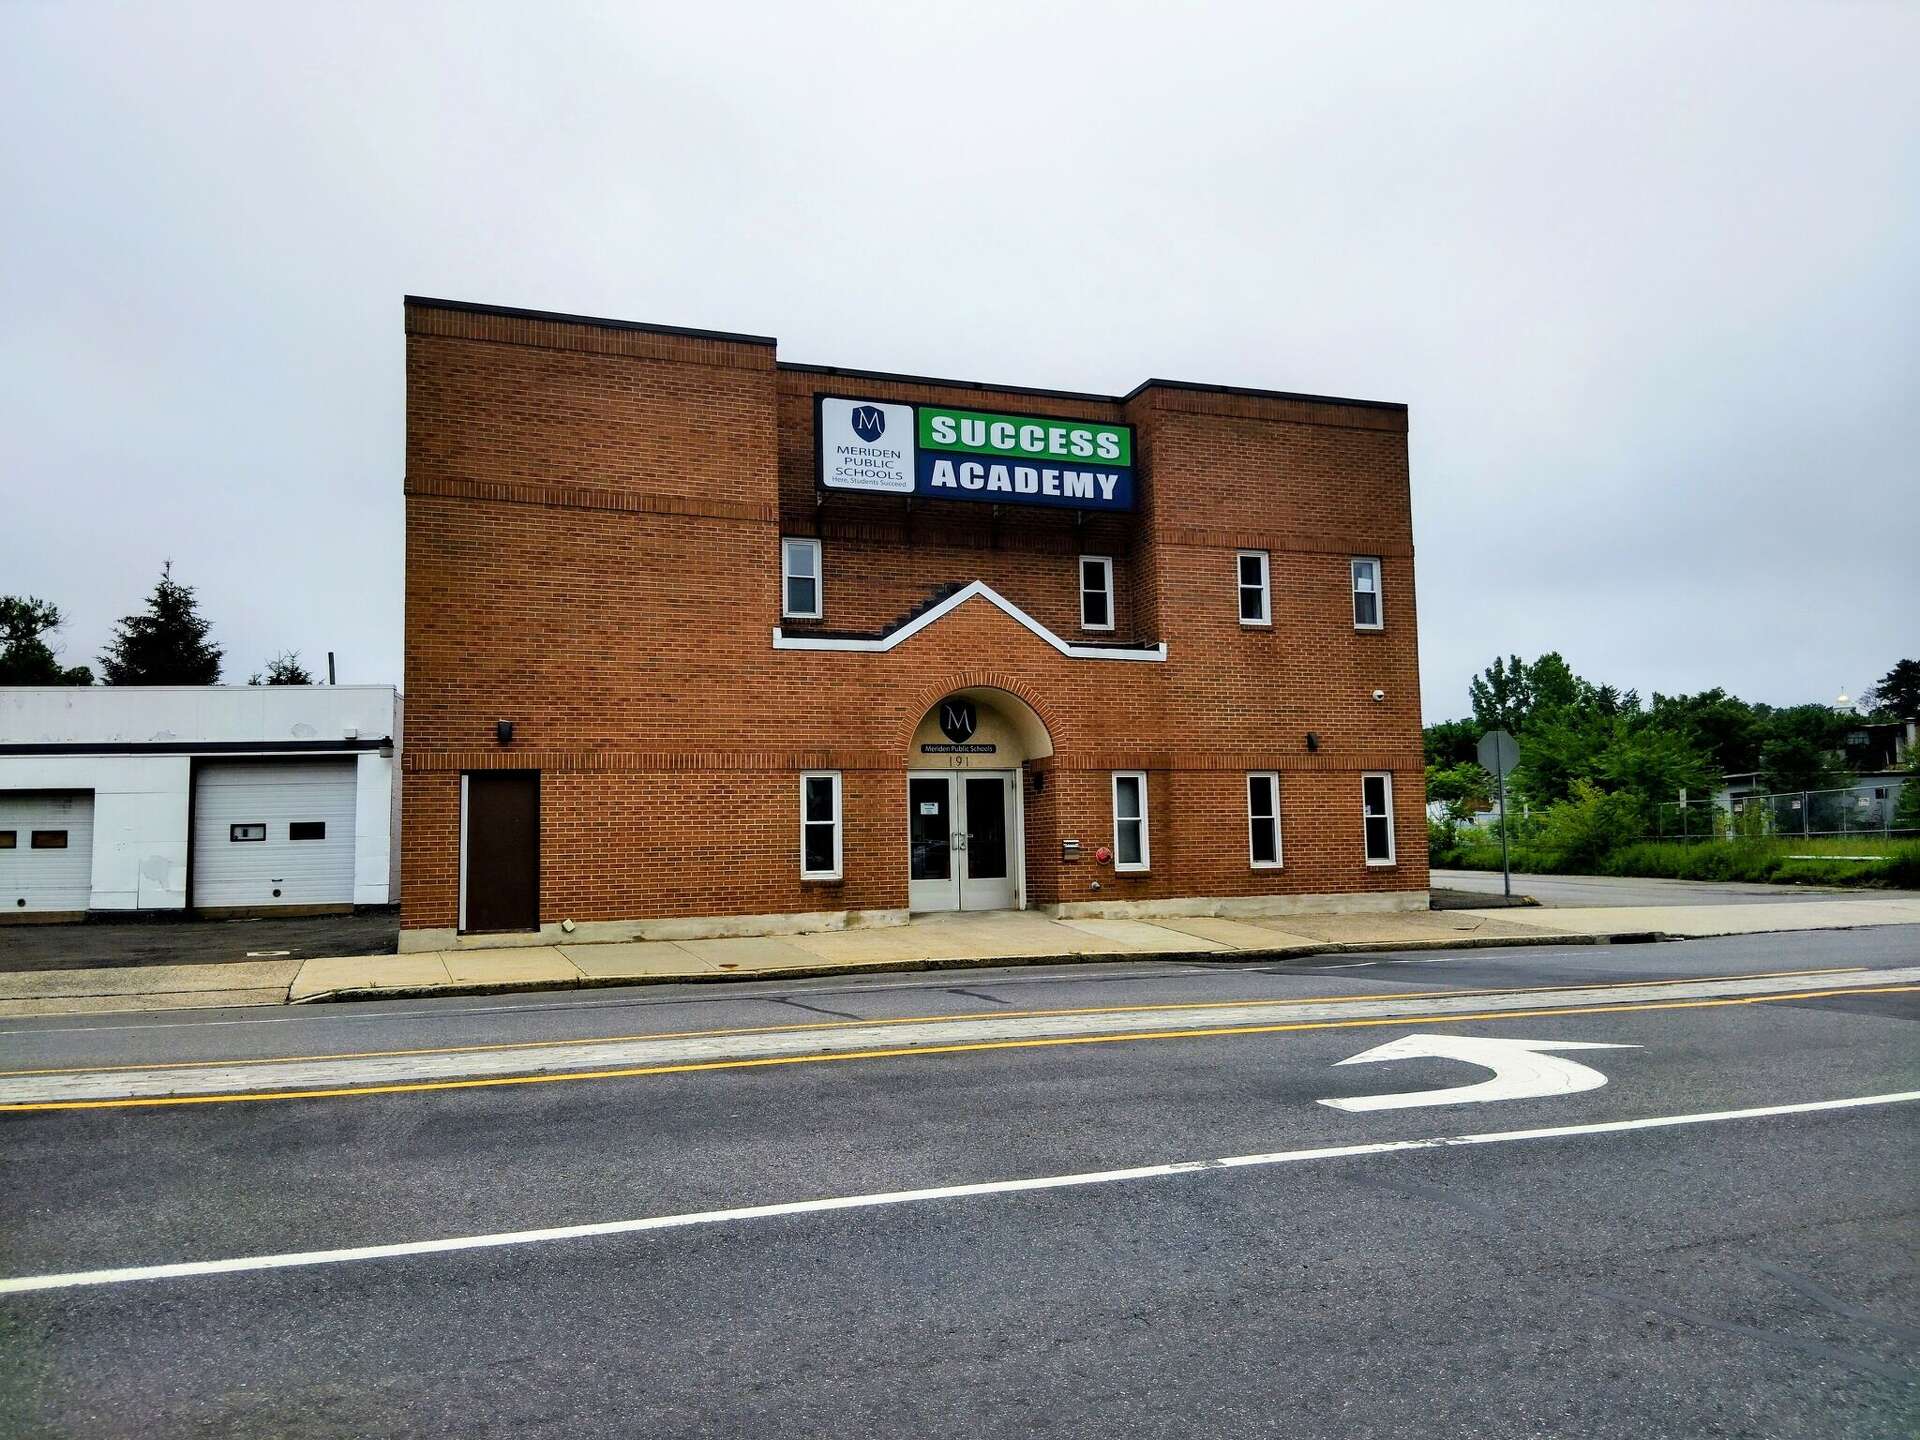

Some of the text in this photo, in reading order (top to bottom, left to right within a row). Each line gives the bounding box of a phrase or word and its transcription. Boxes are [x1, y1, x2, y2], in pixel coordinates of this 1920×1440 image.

[858, 407, 883, 434] M
[931, 416, 1120, 459] SUCCESS
[837, 446, 901, 459] MERIDEN
[844, 457, 895, 469] PUBLIC
[835, 467, 903, 480] SCHOOLS
[931, 460, 1119, 500] ACADEMY
[850, 477, 879, 486] Students
[881, 479, 907, 488] Succeed
[945, 705, 973, 734] M
[949, 756, 969, 767] 191
